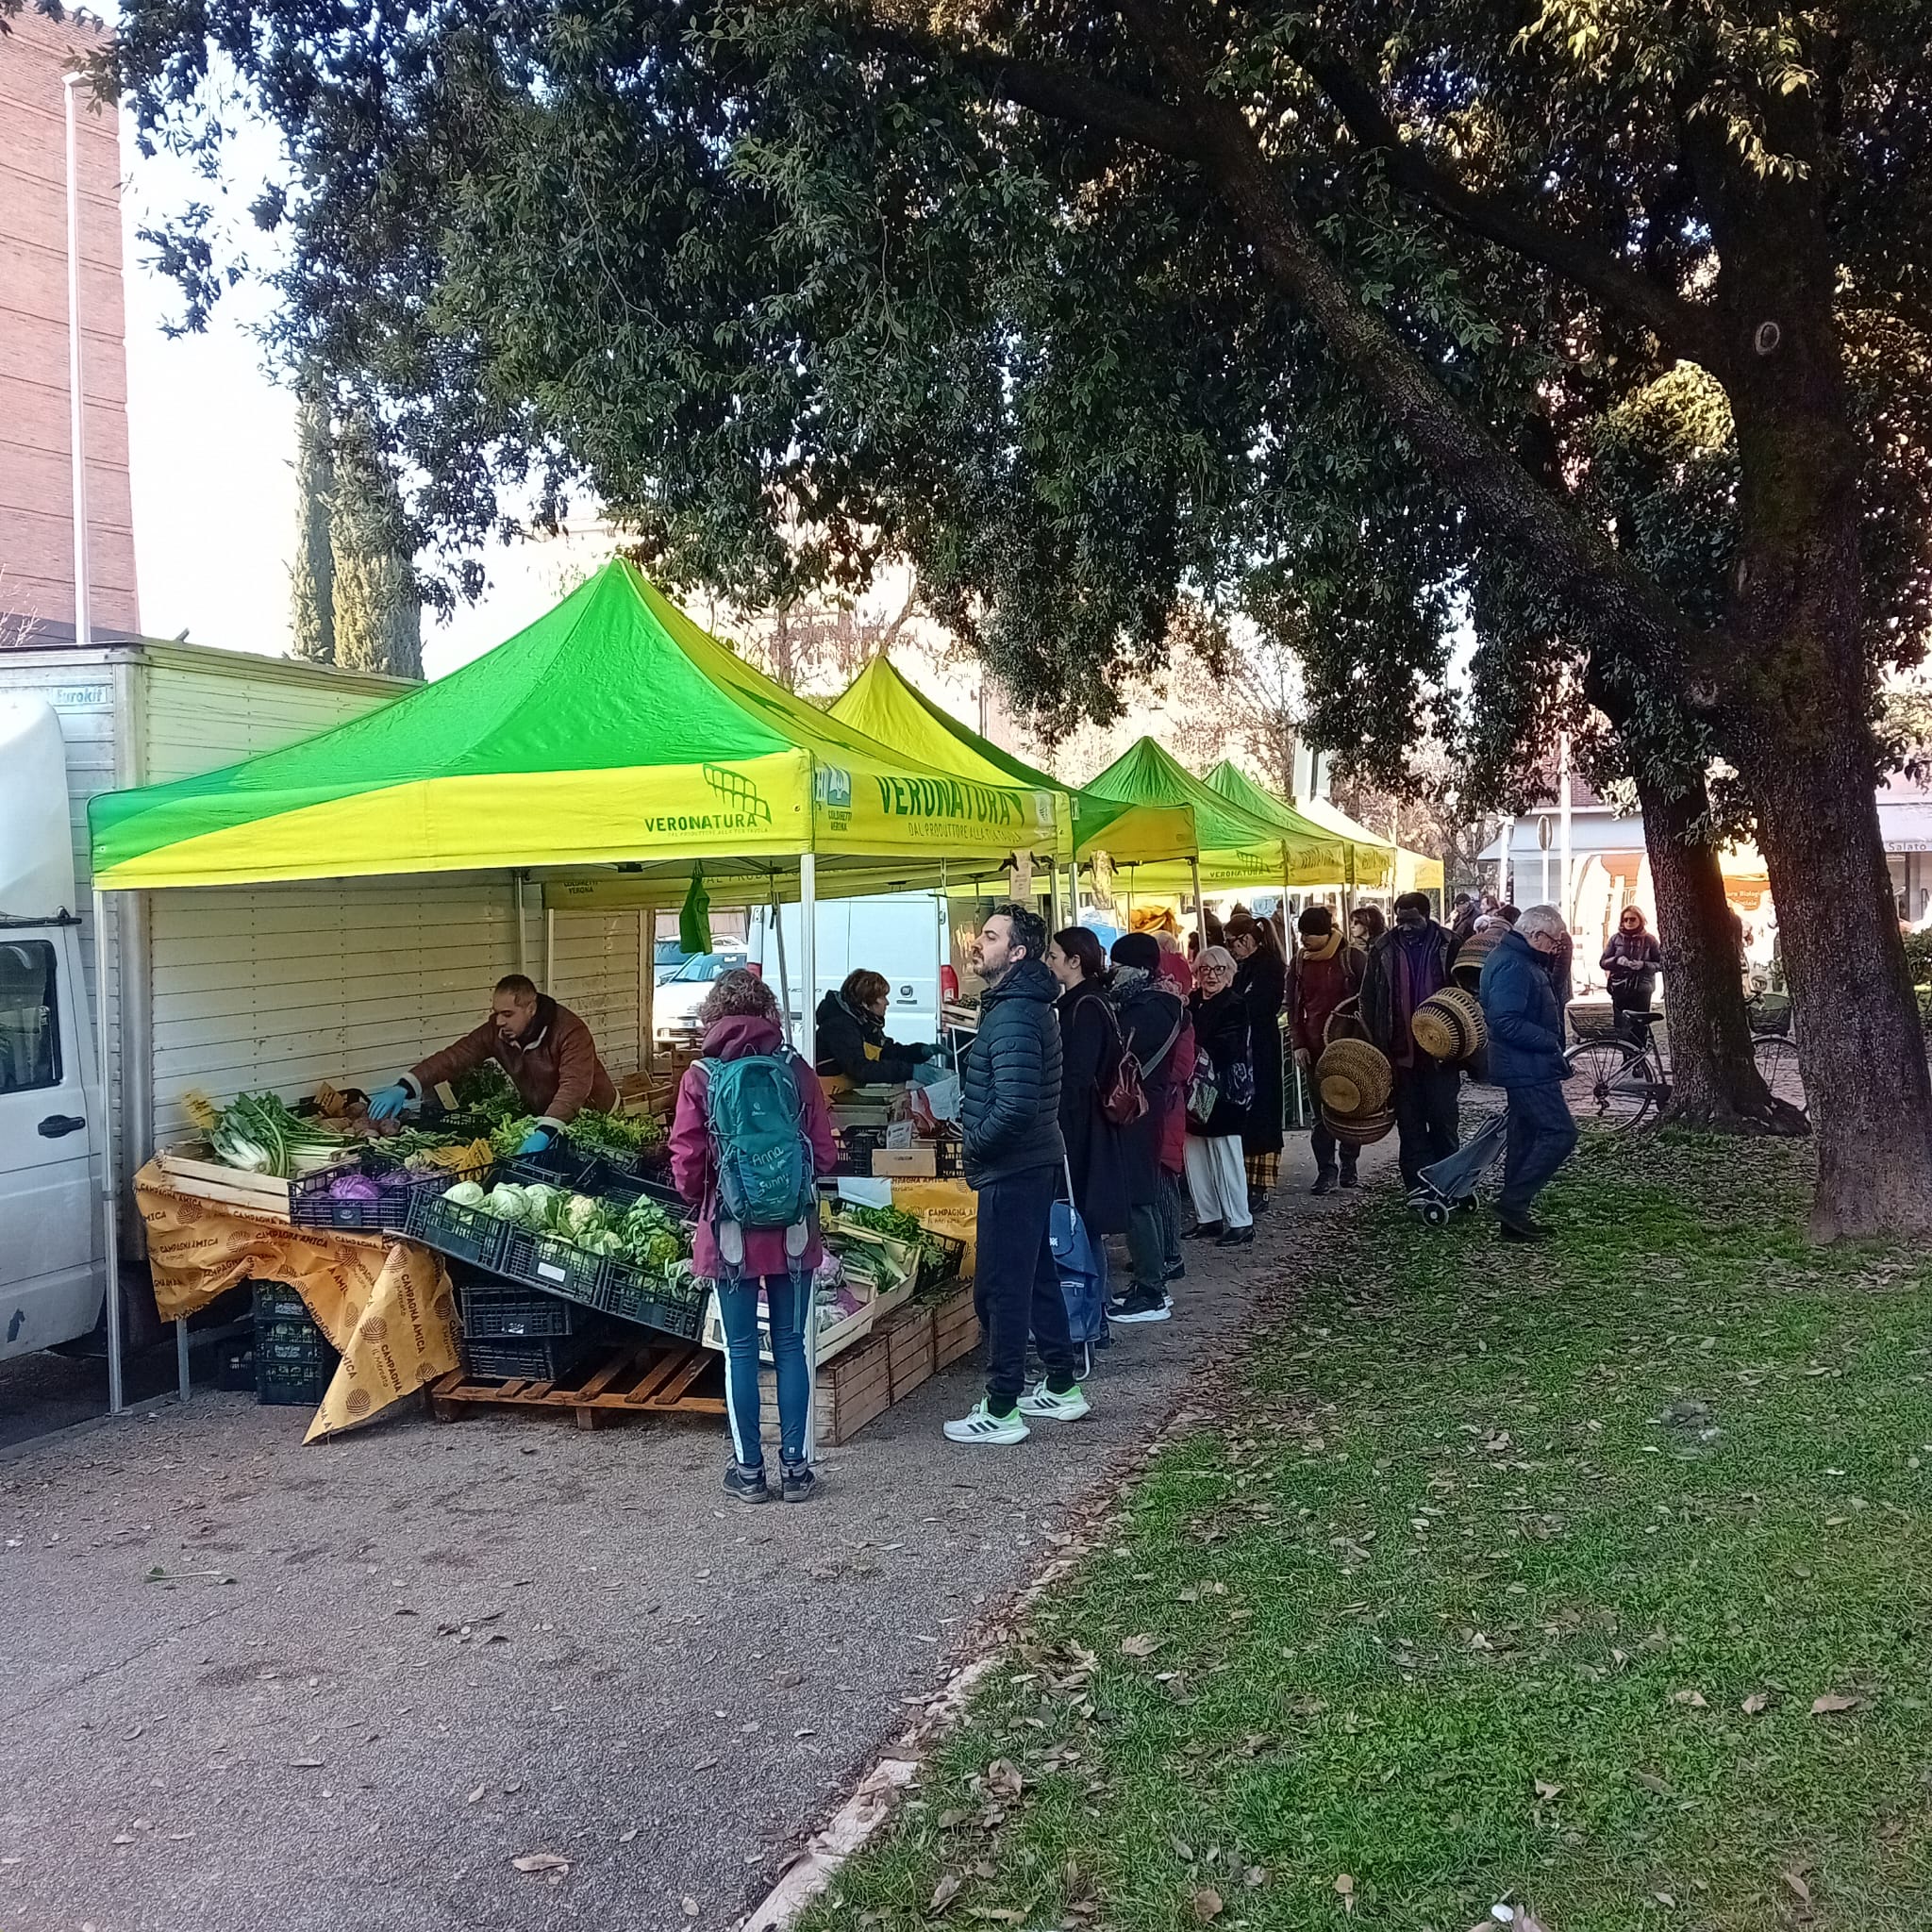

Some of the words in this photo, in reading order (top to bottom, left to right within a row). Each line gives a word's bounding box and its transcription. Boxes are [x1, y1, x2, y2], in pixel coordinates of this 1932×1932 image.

[873, 774, 1010, 825] VERONATURA
[644, 814, 758, 832] VERONATURA
[1888, 841, 1926, 852] Salato
[1209, 869, 1264, 878] VERONATURA
[752, 1145, 785, 1167] Anna
[143, 1211, 167, 1223] MICA
[299, 1236, 328, 1249] AMICA
[307, 1301, 337, 1344] CAMPAGNA
[401, 1274, 420, 1323] CAMPAGNA
[413, 1323, 426, 1354] AMICA
[380, 1343, 403, 1393] CAMPAGNA
